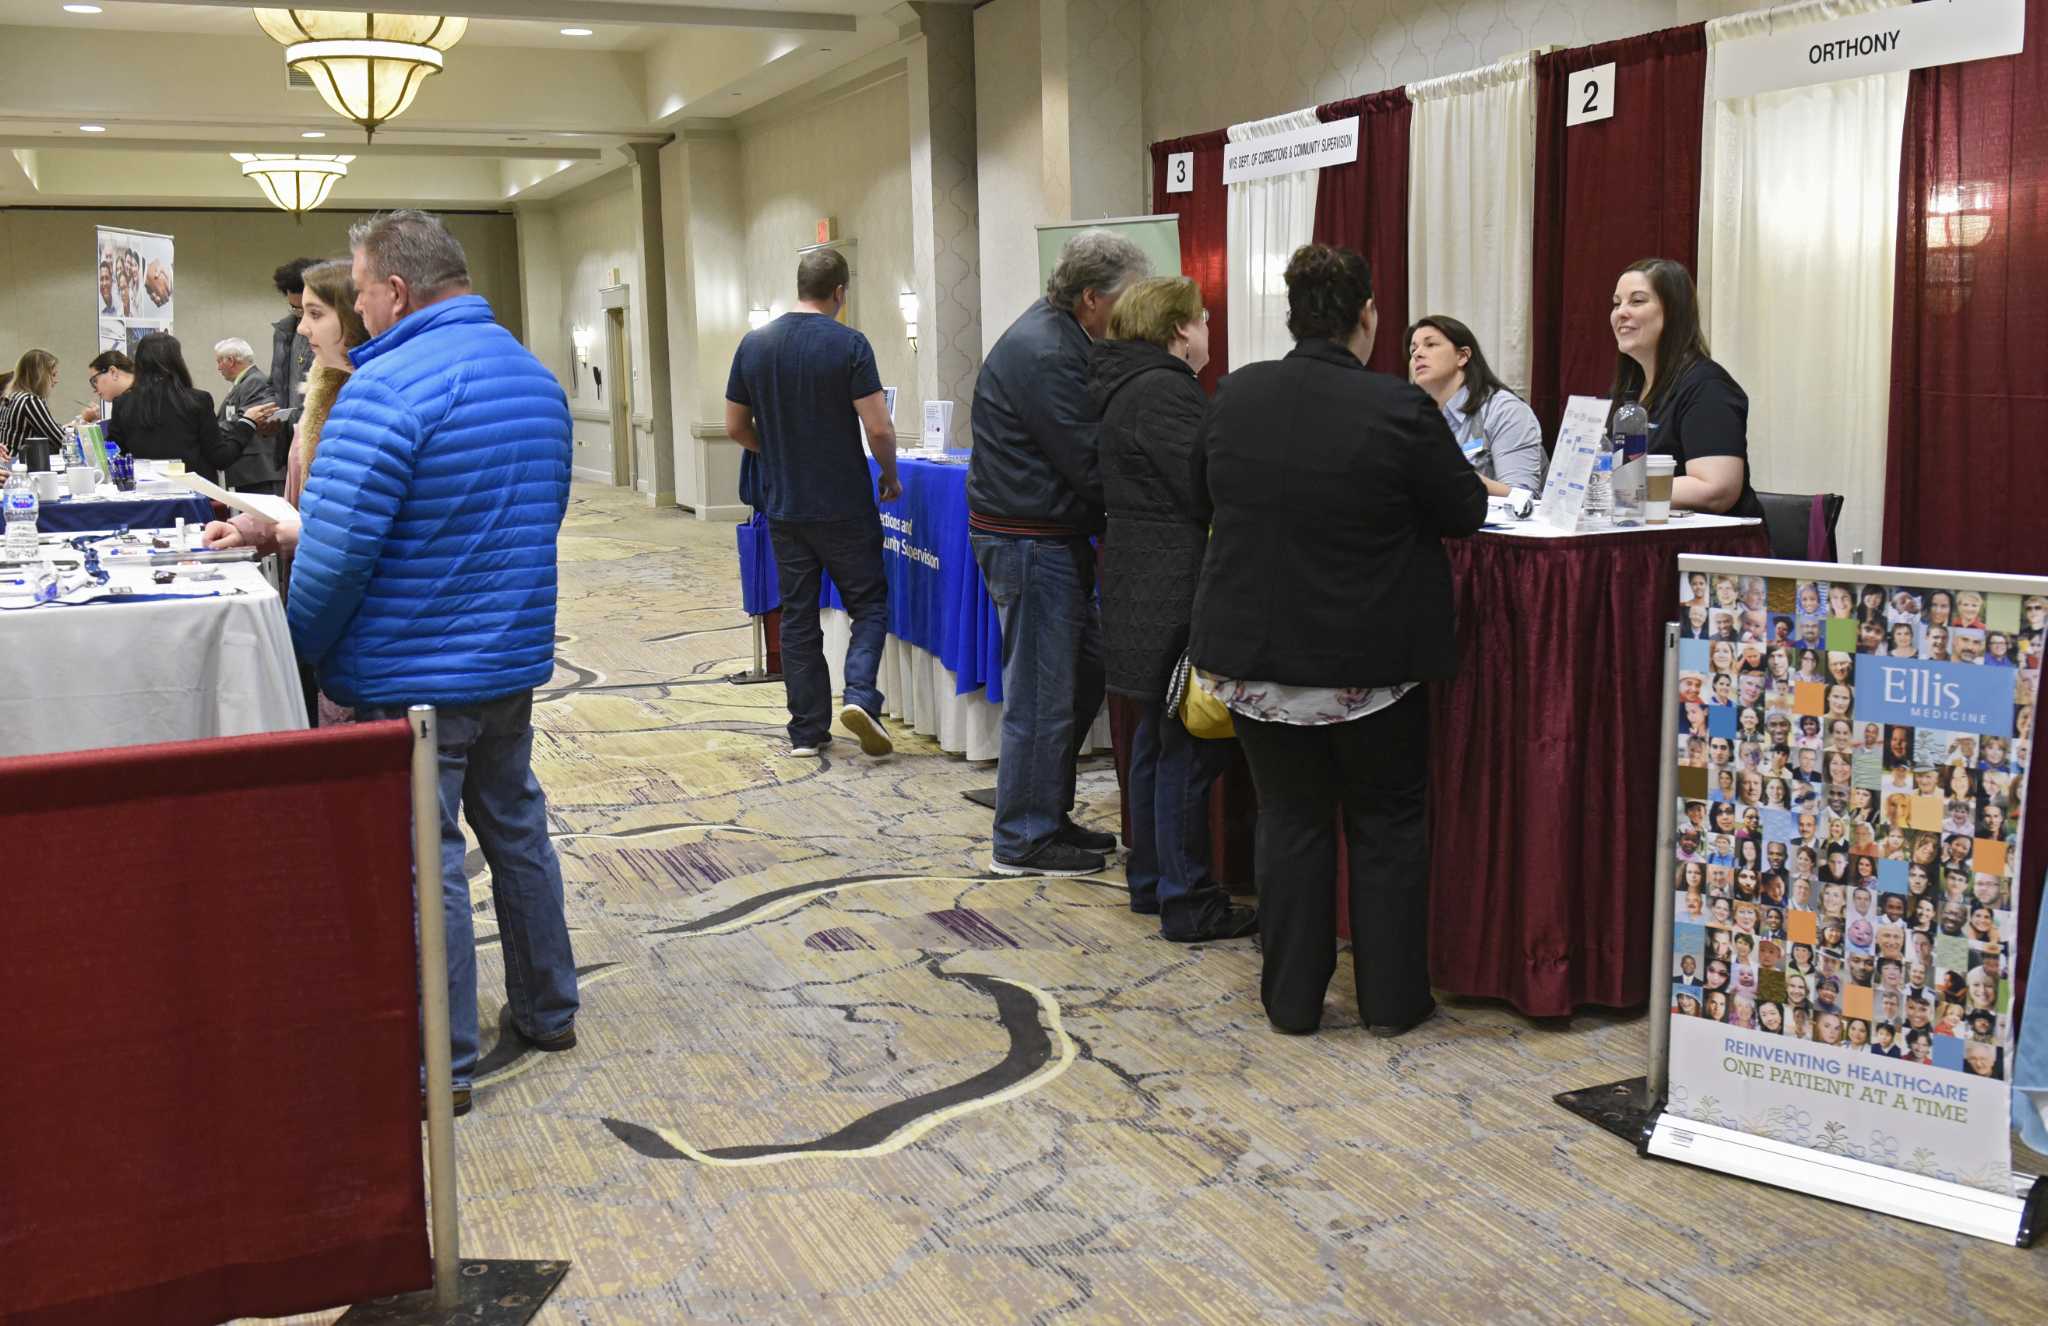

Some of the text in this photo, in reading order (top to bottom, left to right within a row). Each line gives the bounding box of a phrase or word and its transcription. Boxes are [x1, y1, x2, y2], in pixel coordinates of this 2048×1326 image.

[1808, 29, 1901, 65] ORTHONY
[1582, 80, 1599, 113] 2
[1250, 152, 1259, 166] OF
[1258, 147, 1288, 165] CORRECTIONS
[1293, 139, 1321, 158] COMMUNITY
[1321, 133, 1353, 153] SUPERVISION
[1176, 159, 1186, 184] 3
[879, 511, 912, 536] ections and
[901, 538, 940, 571] Supervision
[1880, 665, 1961, 710] Ellis
[1910, 706, 1988, 725] MEDICINE
[1725, 1037, 1969, 1103] REINVENTING HEALTHCARE
[1722, 1056, 1969, 1125] ONE PATIENT AT A TIME
